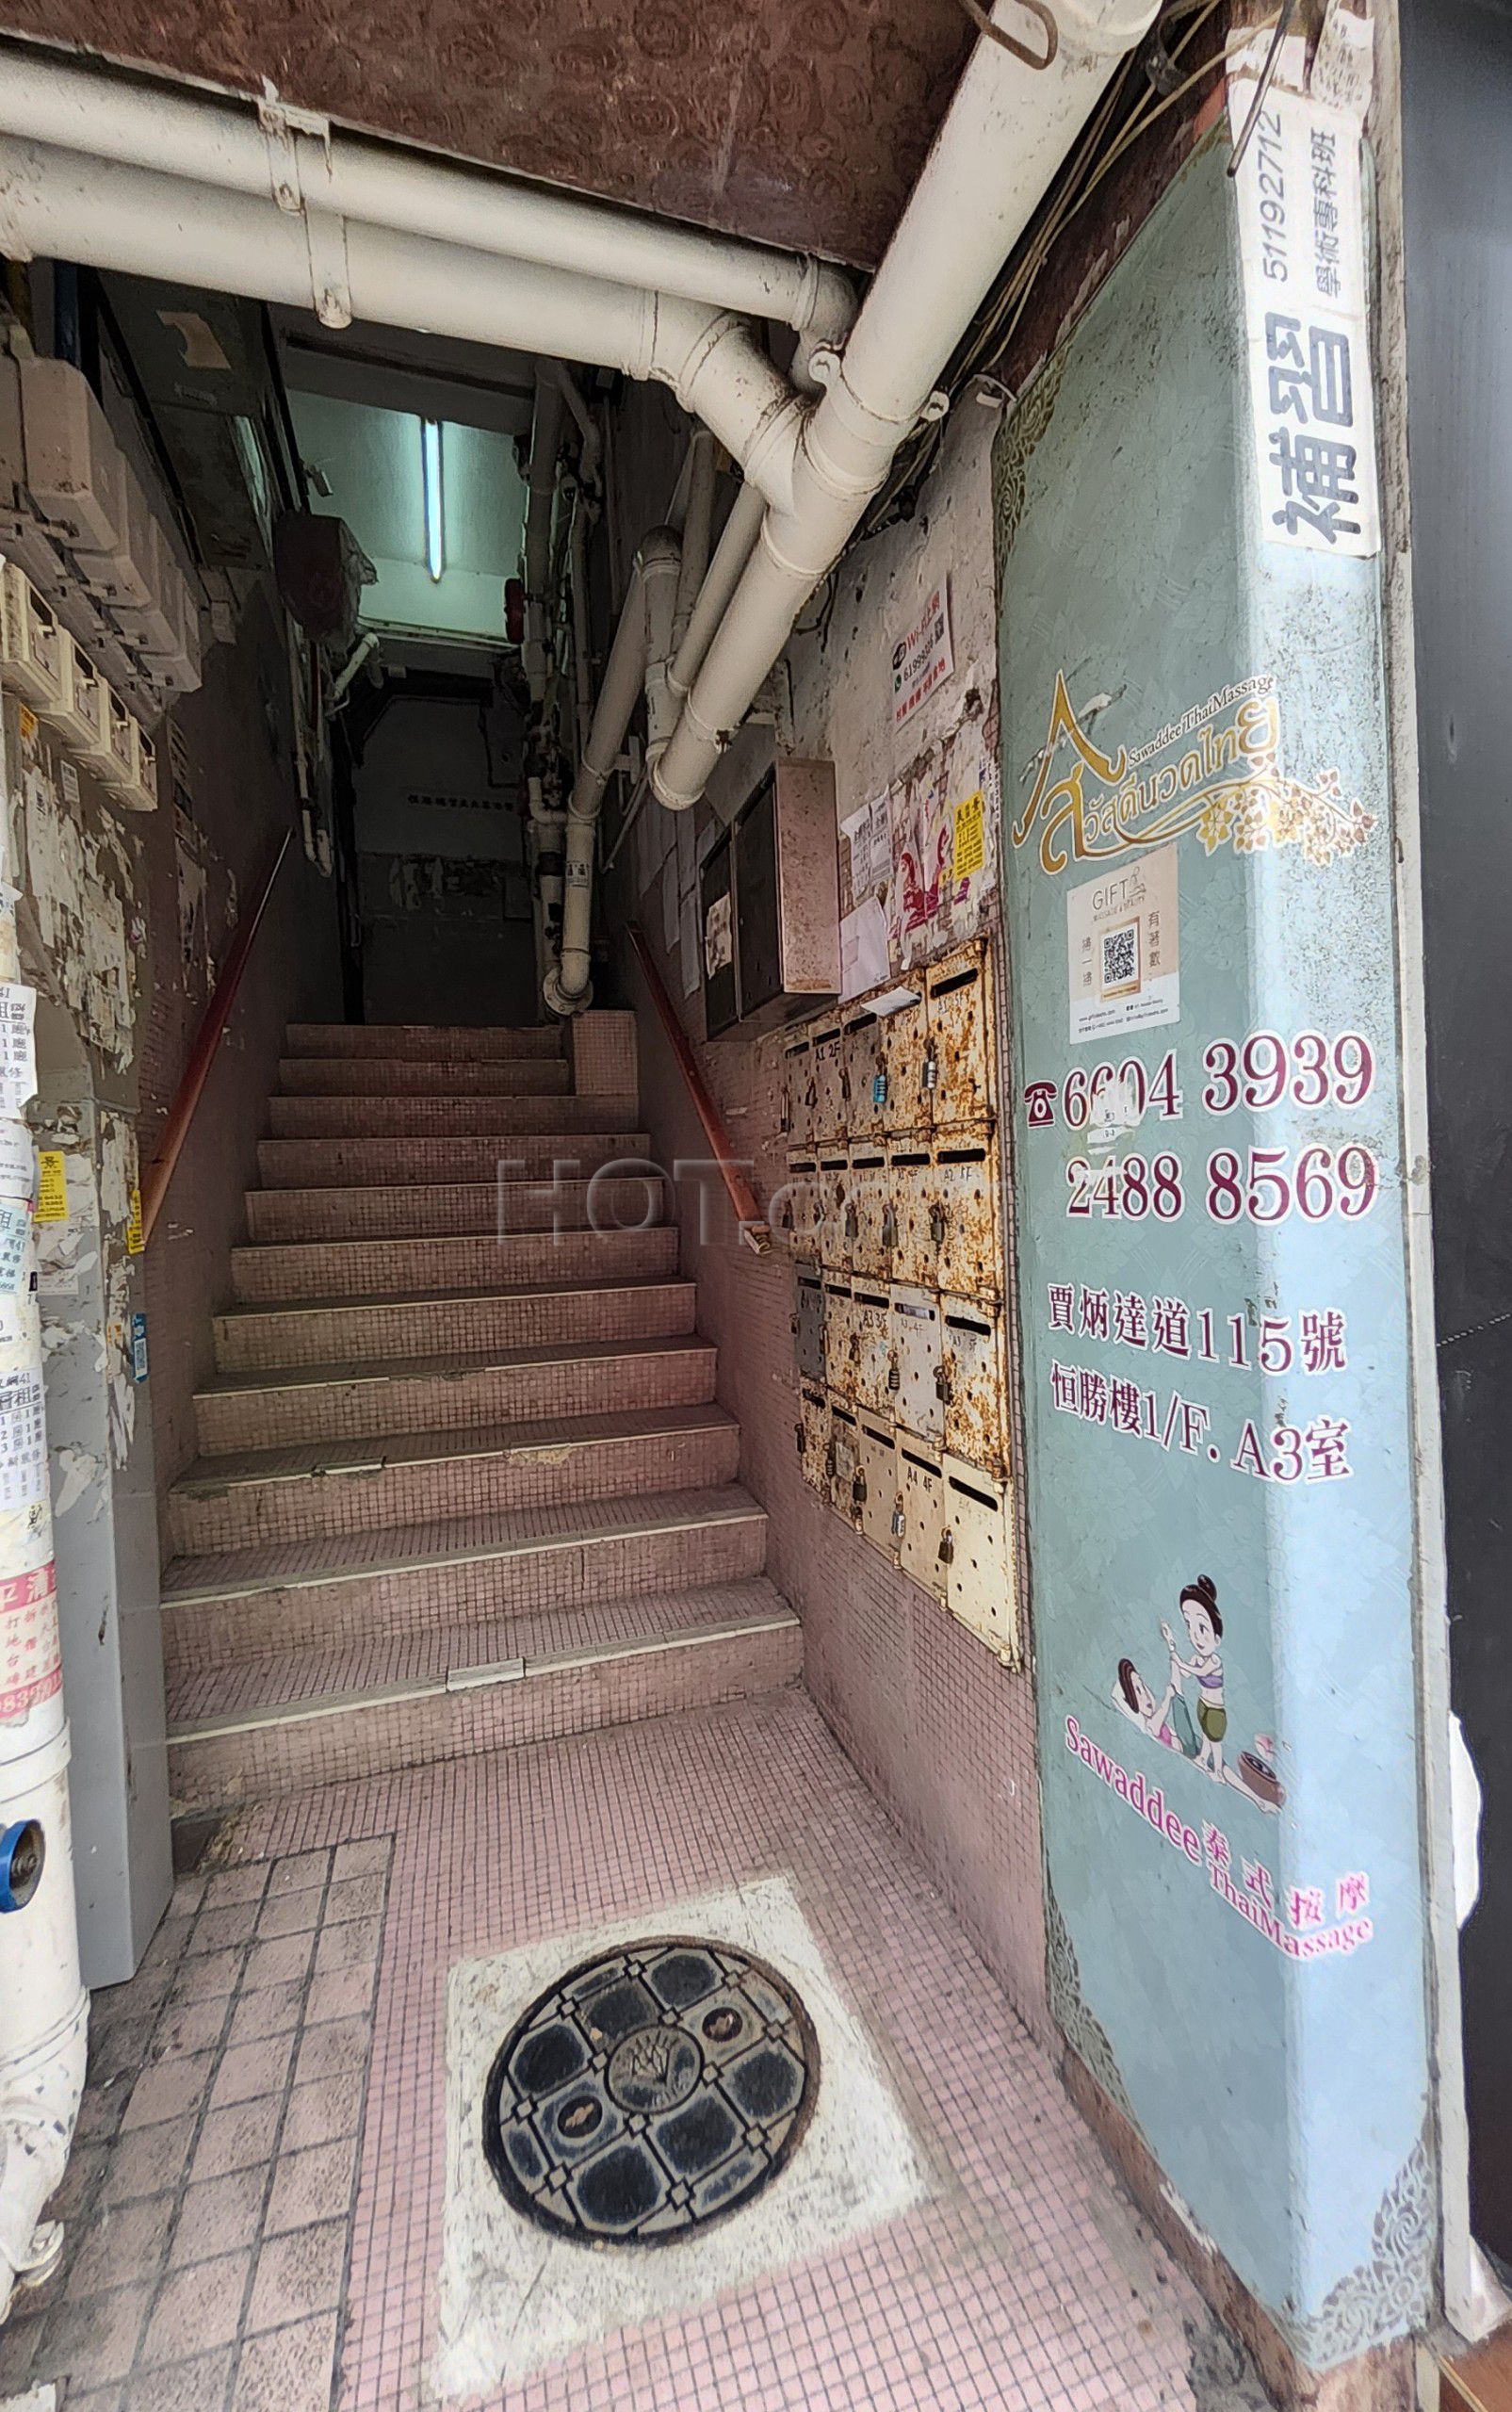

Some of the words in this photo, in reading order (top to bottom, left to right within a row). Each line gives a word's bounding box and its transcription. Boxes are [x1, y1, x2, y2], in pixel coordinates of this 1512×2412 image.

[1255, 109, 1287, 281] 51192712
[1310, 127, 1340, 298] 學術專科班
[1265, 312, 1360, 544] 補習
[1093, 878, 1128, 910] GIFT
[1205, 1033, 1374, 1113] 3939
[1067, 1154, 1182, 1219] 2488
[1209, 1147, 1375, 1222] 8569
[1049, 1285, 1347, 1373] 賈炳達道115號
[907, 1466, 918, 1487] A4
[922, 1475, 933, 1493] 4F
[1232, 1418, 1350, 1481] A3室
[1065, 1718, 1200, 1863] Sawaddee
[1205, 1824, 1369, 1927] 泰式按摩
[1211, 1865, 1372, 1958] ThaiMassage
